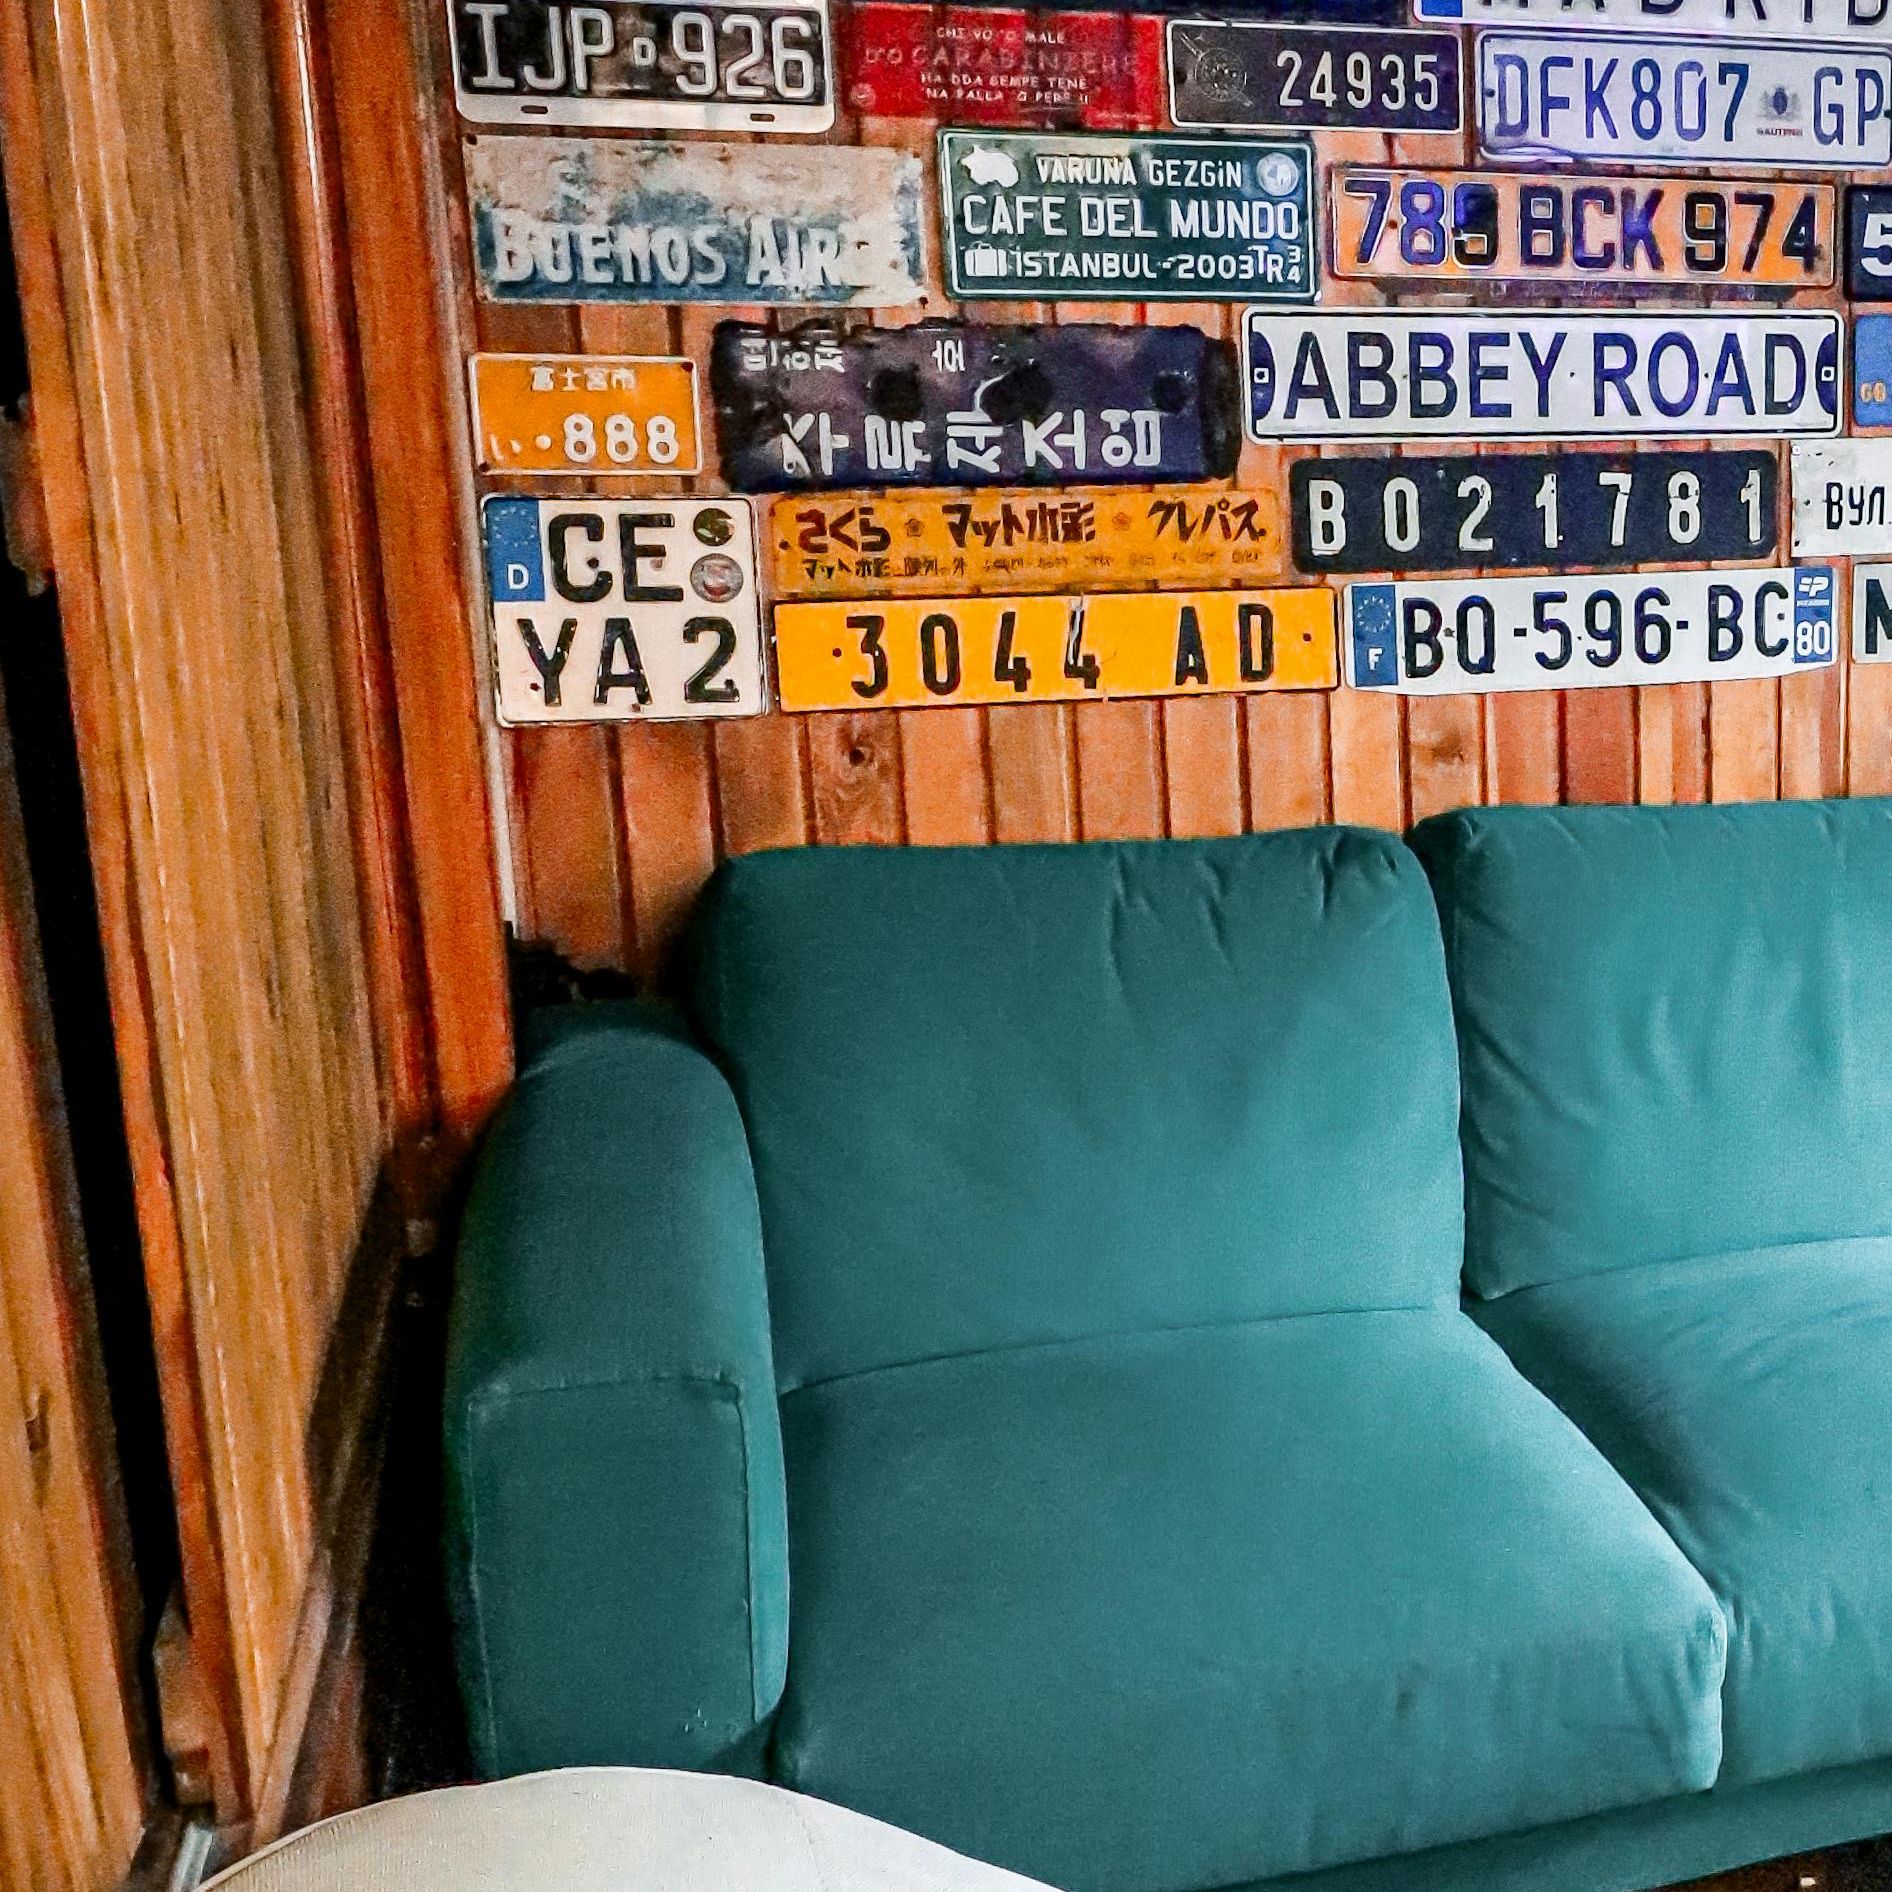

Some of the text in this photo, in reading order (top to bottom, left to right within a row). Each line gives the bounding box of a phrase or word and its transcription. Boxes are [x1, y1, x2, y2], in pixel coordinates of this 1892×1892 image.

[672, 11, 816, 99] 926
[1275, 49, 1440, 111] 24935
[1493, 54, 1886, 147] DFK807 GP
[1035, 156, 1136, 187] VARUNA
[497, 209, 728, 285] BUENOS
[962, 195, 1300, 241] CAFE DEL MUNDO
[1520, 187, 1820, 274] BCK 974
[1284, 332, 1806, 419] ABBEY ROAD
[563, 413, 678, 465] 888
[508, 512, 684, 603] D CE
[846, 602, 1274, 699] 3044 AD
[1367, 622, 1830, 671] F 80
